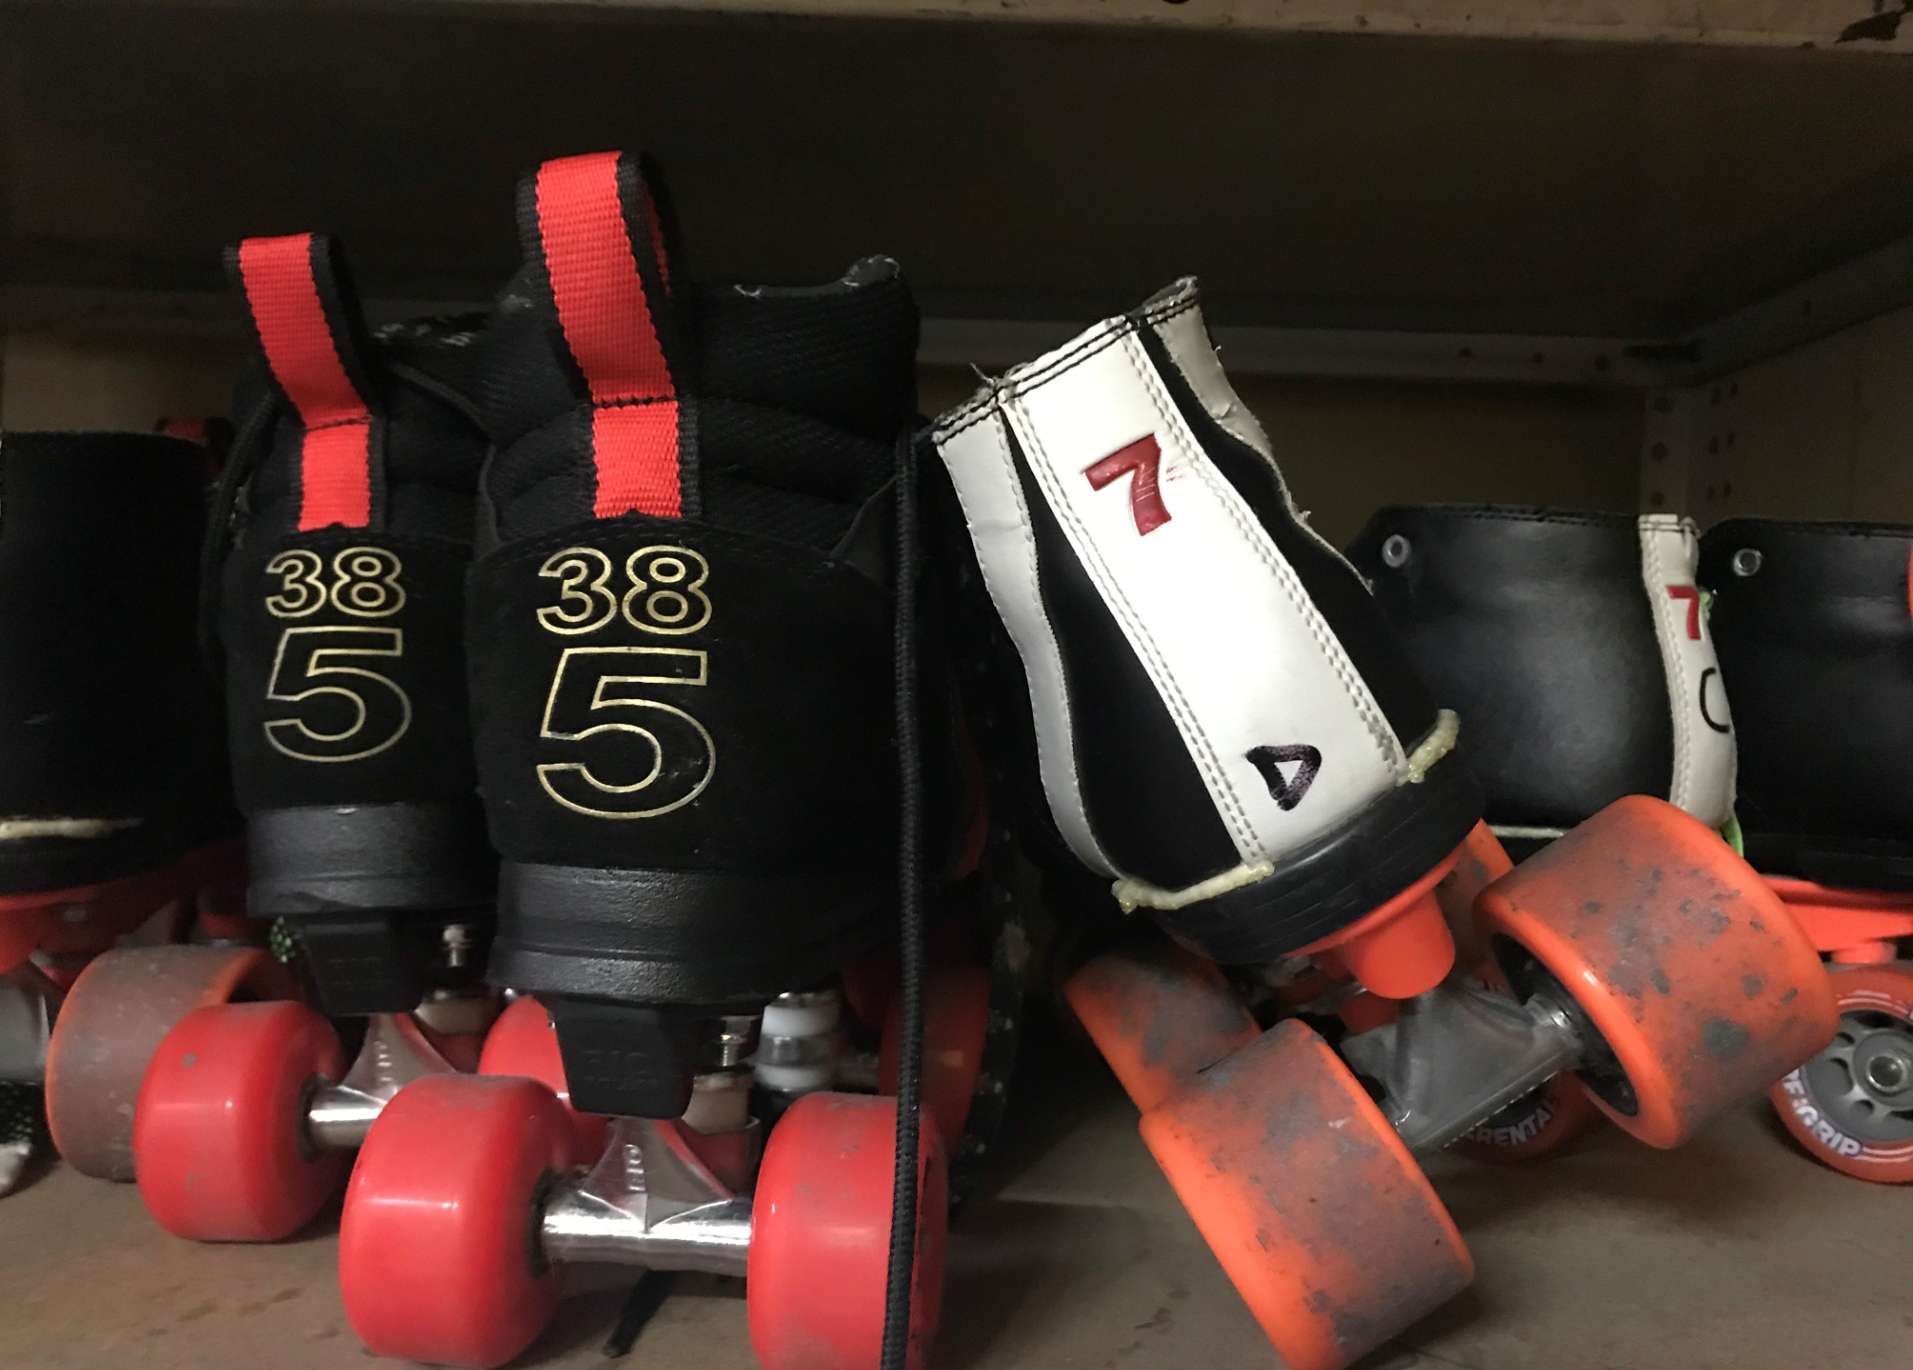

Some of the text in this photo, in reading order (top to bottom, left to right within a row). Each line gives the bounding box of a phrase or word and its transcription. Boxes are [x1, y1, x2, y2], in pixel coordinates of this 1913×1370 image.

[1081, 433, 1172, 536] 7
[265, 546, 407, 618] 38
[537, 545, 713, 635] 38
[1666, 585, 1701, 640] 7
[264, 626, 412, 762] 5
[537, 646, 716, 819] 5
